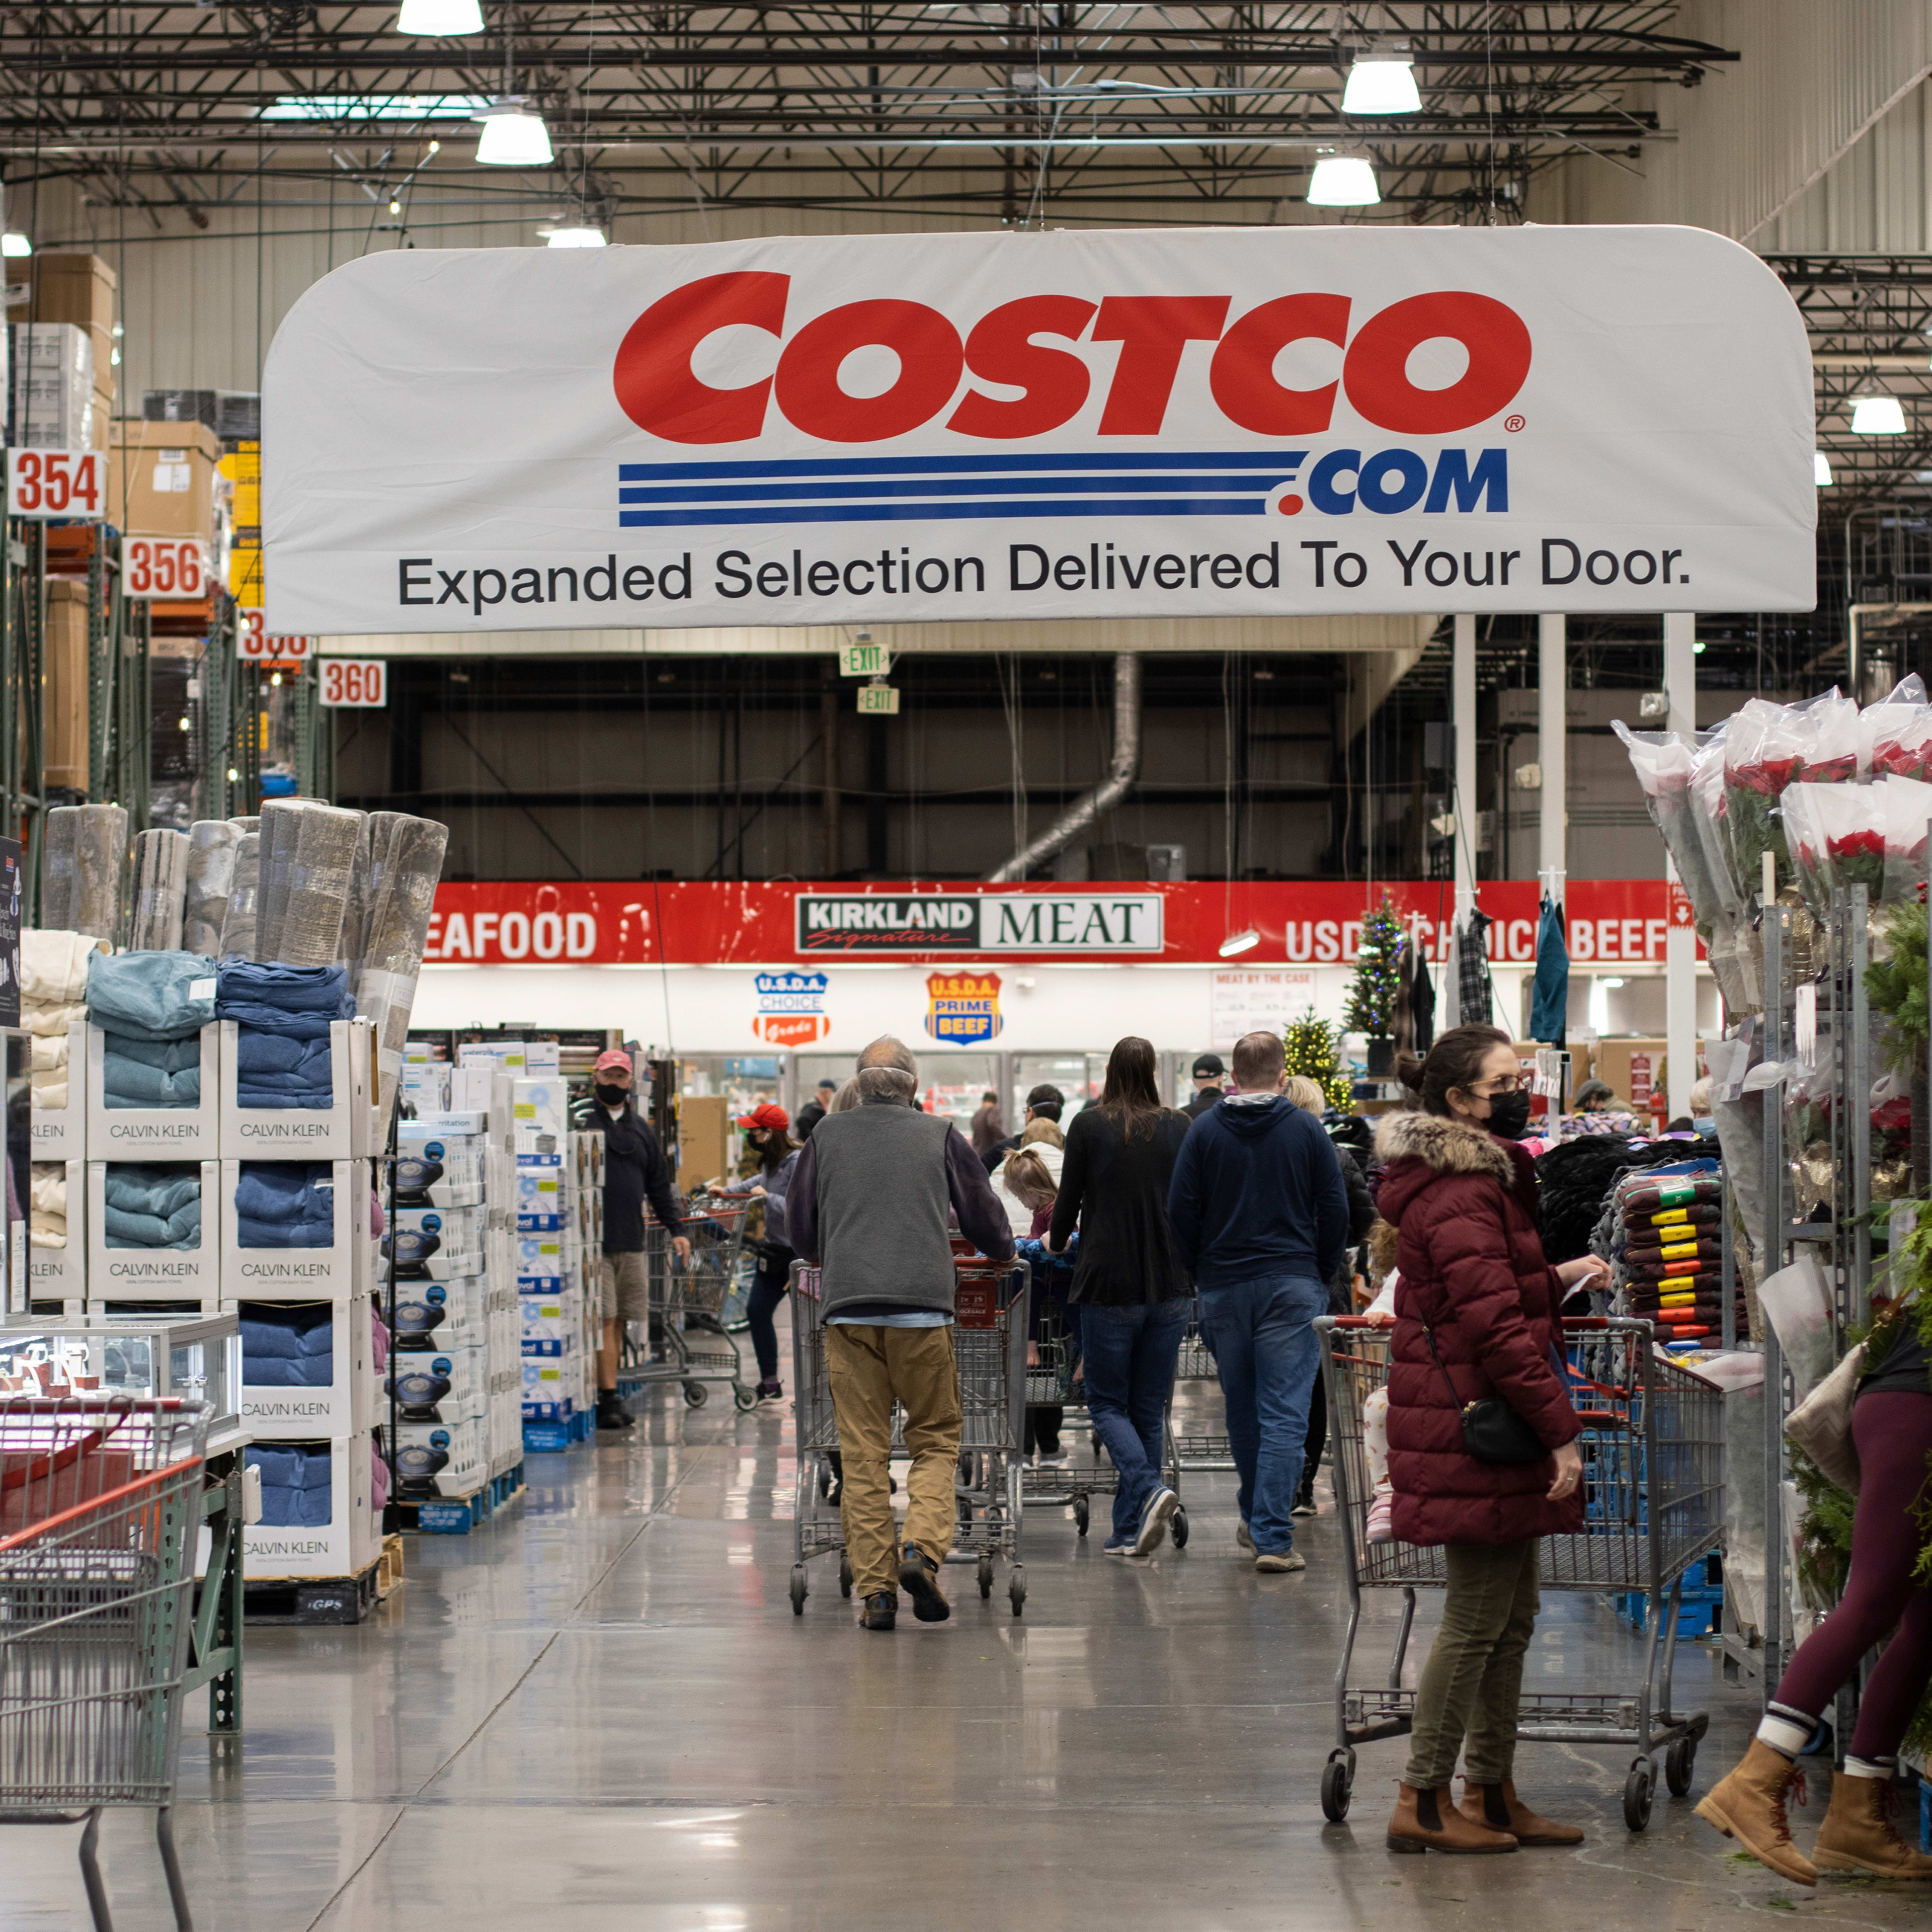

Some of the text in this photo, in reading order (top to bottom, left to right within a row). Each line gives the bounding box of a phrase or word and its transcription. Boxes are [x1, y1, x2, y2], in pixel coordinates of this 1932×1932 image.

[613, 271, 1532, 445] COSTCO
[17, 452, 99, 511] 354
[130, 542, 200, 592] 356
[399, 539, 1689, 615] Expanded Selection Delivered To Your Door.
[850, 647, 880, 672] EXIT
[326, 663, 381, 702] 360
[866, 690, 892, 709] EXIT
[809, 903, 974, 929] KIRKLAND
[997, 903, 1144, 944] MEAT
[423, 912, 597, 959] EAFOOD
[807, 928, 971, 949] Signature
[1285, 921, 1364, 961] USD
[1570, 919, 1667, 959] BEEF
[758, 977, 824, 991] U.S.D.A.
[931, 979, 997, 996] U.S.D.A.
[1217, 973, 1310, 984] MEAT BY THE CASE
[760, 996, 821, 1009] CHOICE
[935, 1000, 993, 1012] PRIME
[766, 1020, 812, 1042] Grade
[939, 1017, 989, 1035] BEEF
[110, 1125, 199, 1138] CALVIN KLEIN
[240, 1124, 329, 1137] CALVIN KLEIN
[110, 1263, 199, 1276] CALVIN KLEIN
[242, 1264, 331, 1276] CALVIN KLEIN
[242, 1403, 330, 1416] CALVIN KLEIN
[292, 1541, 328, 1554] KLEIN
